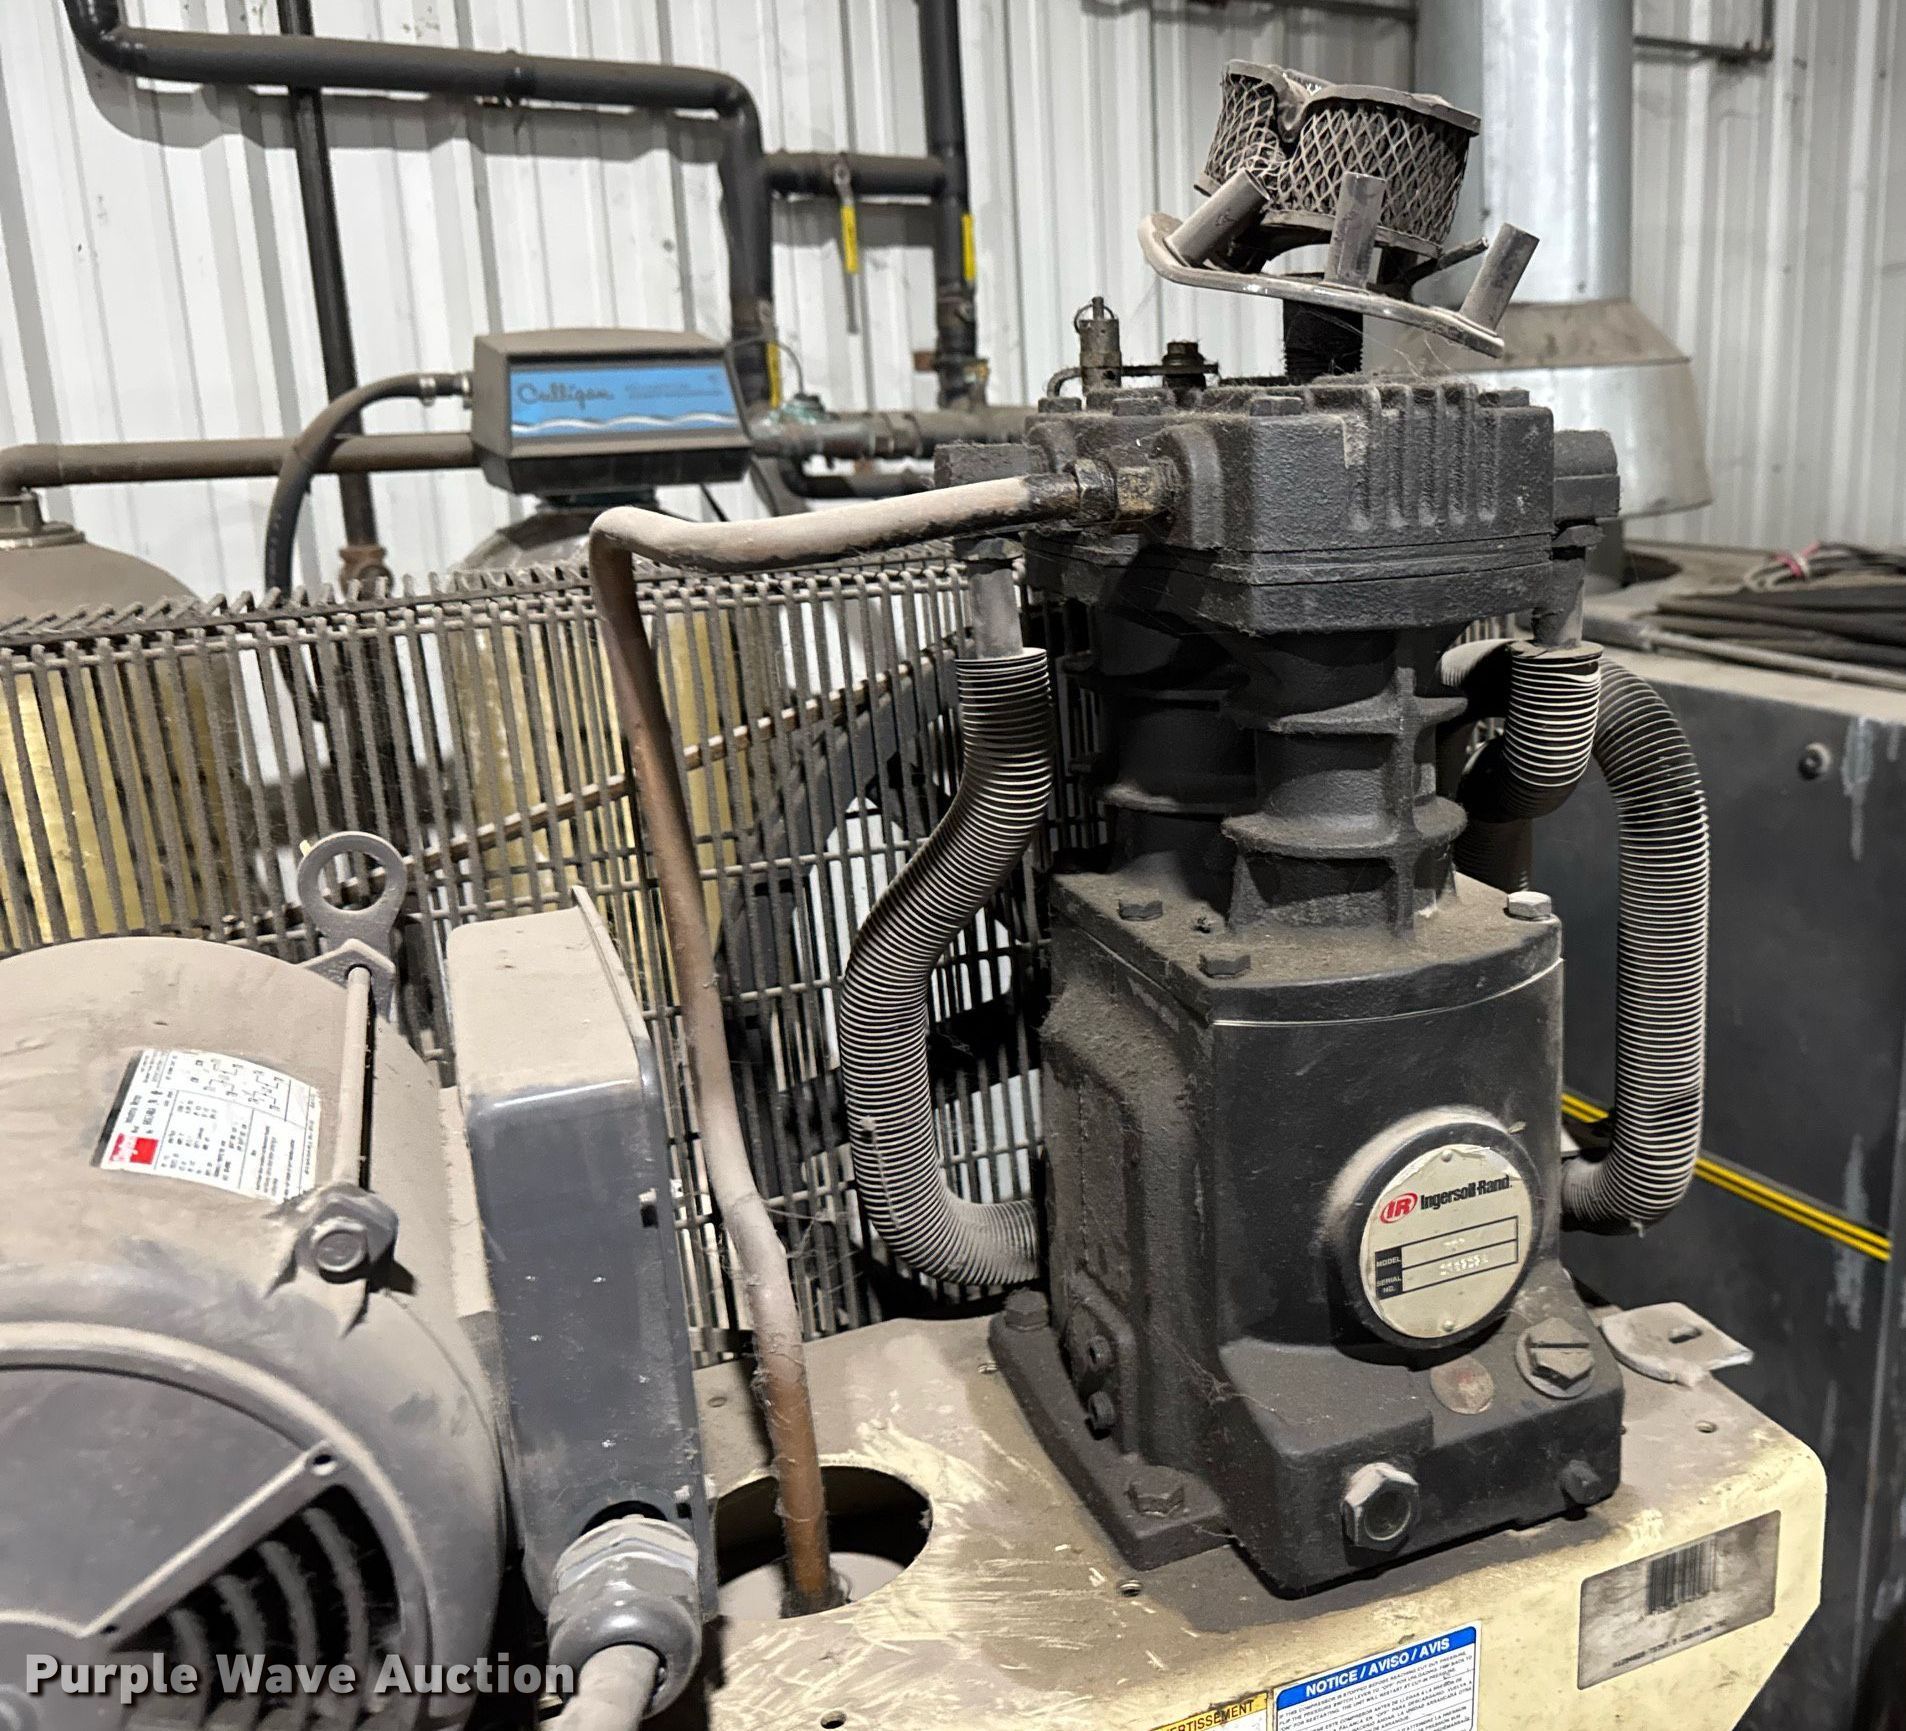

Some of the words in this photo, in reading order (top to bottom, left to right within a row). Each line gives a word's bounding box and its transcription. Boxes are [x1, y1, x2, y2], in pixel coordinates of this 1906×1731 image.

[517, 381, 615, 411] Culligan
[1376, 1256, 1401, 1268] MODEL
[1376, 1276, 1402, 1288] SERIAL
[1305, 1668, 1358, 1697] NOTICE
[1368, 1651, 1409, 1676] AVISO
[1419, 1637, 1450, 1659] AVIS
[1167, 1699, 1254, 1731] RTISSEMENT
